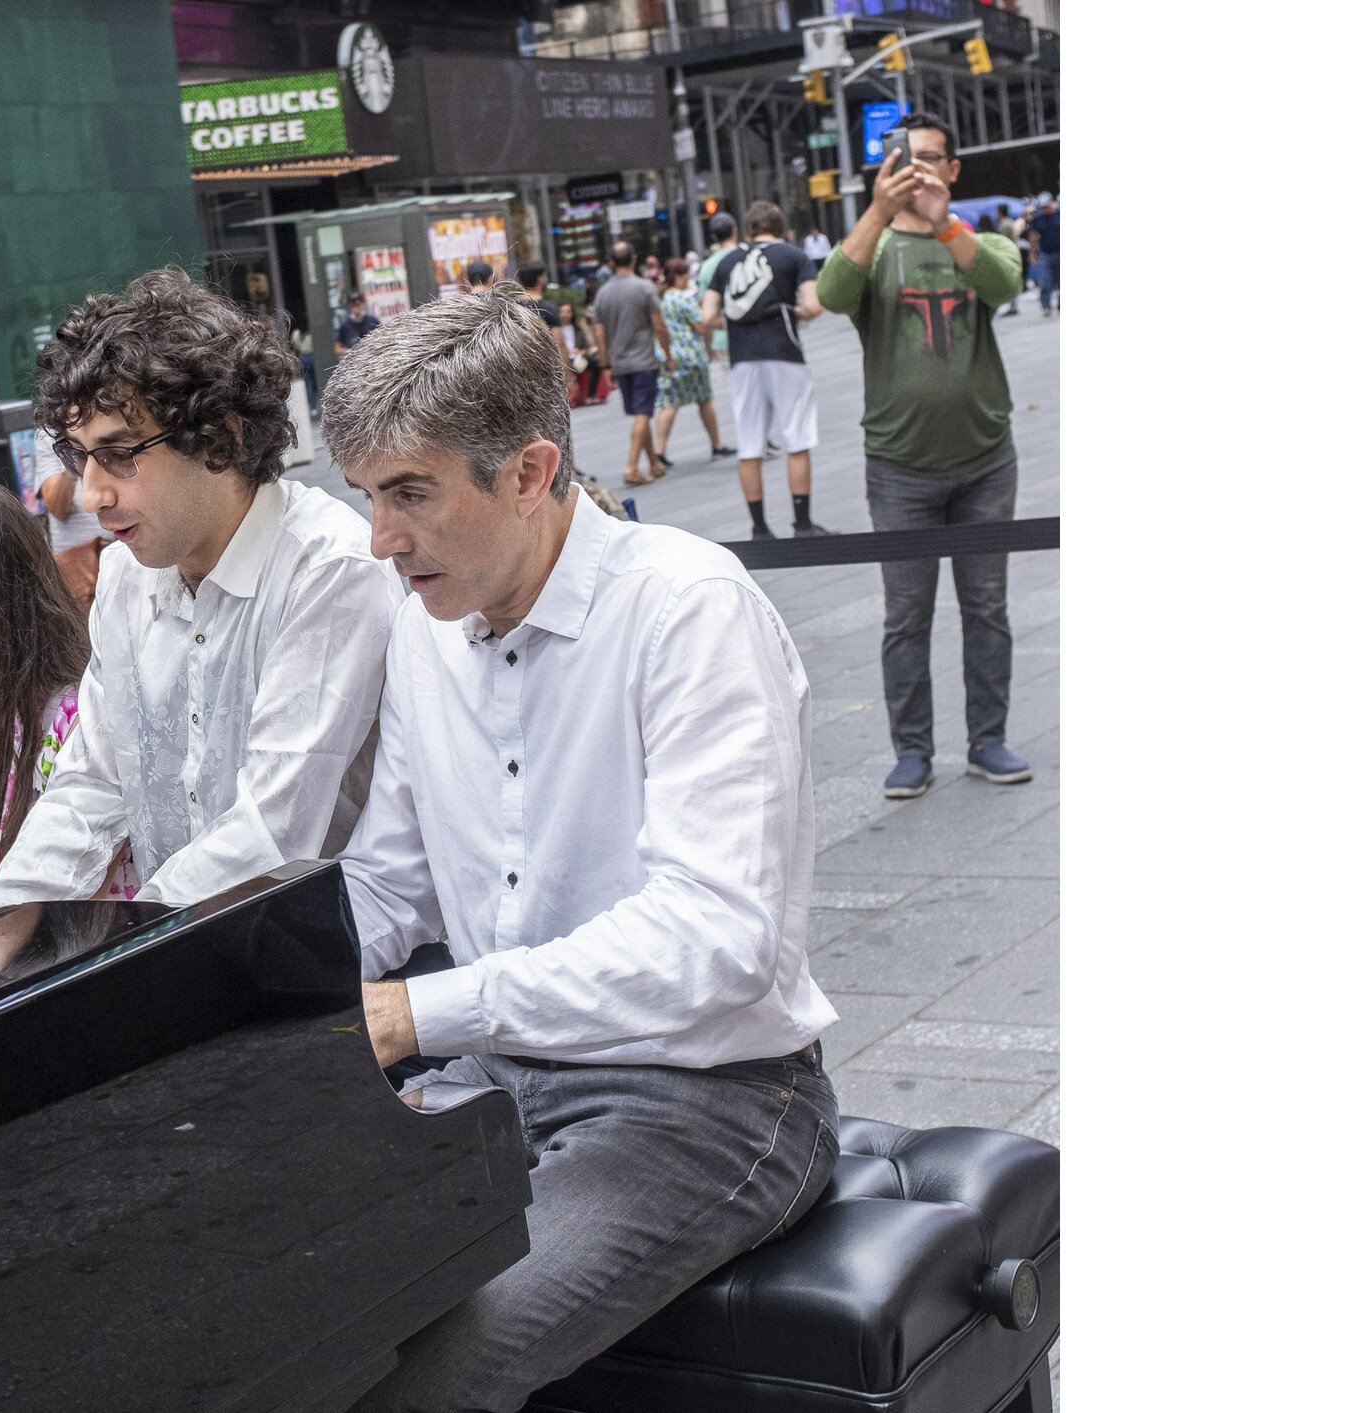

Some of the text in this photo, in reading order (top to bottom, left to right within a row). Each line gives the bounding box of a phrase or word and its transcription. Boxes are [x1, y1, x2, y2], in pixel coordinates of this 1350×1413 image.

[180, 86, 340, 124] TARBUCKS
[191, 119, 306, 151] COFFEE
[363, 250, 404, 269] ATM
